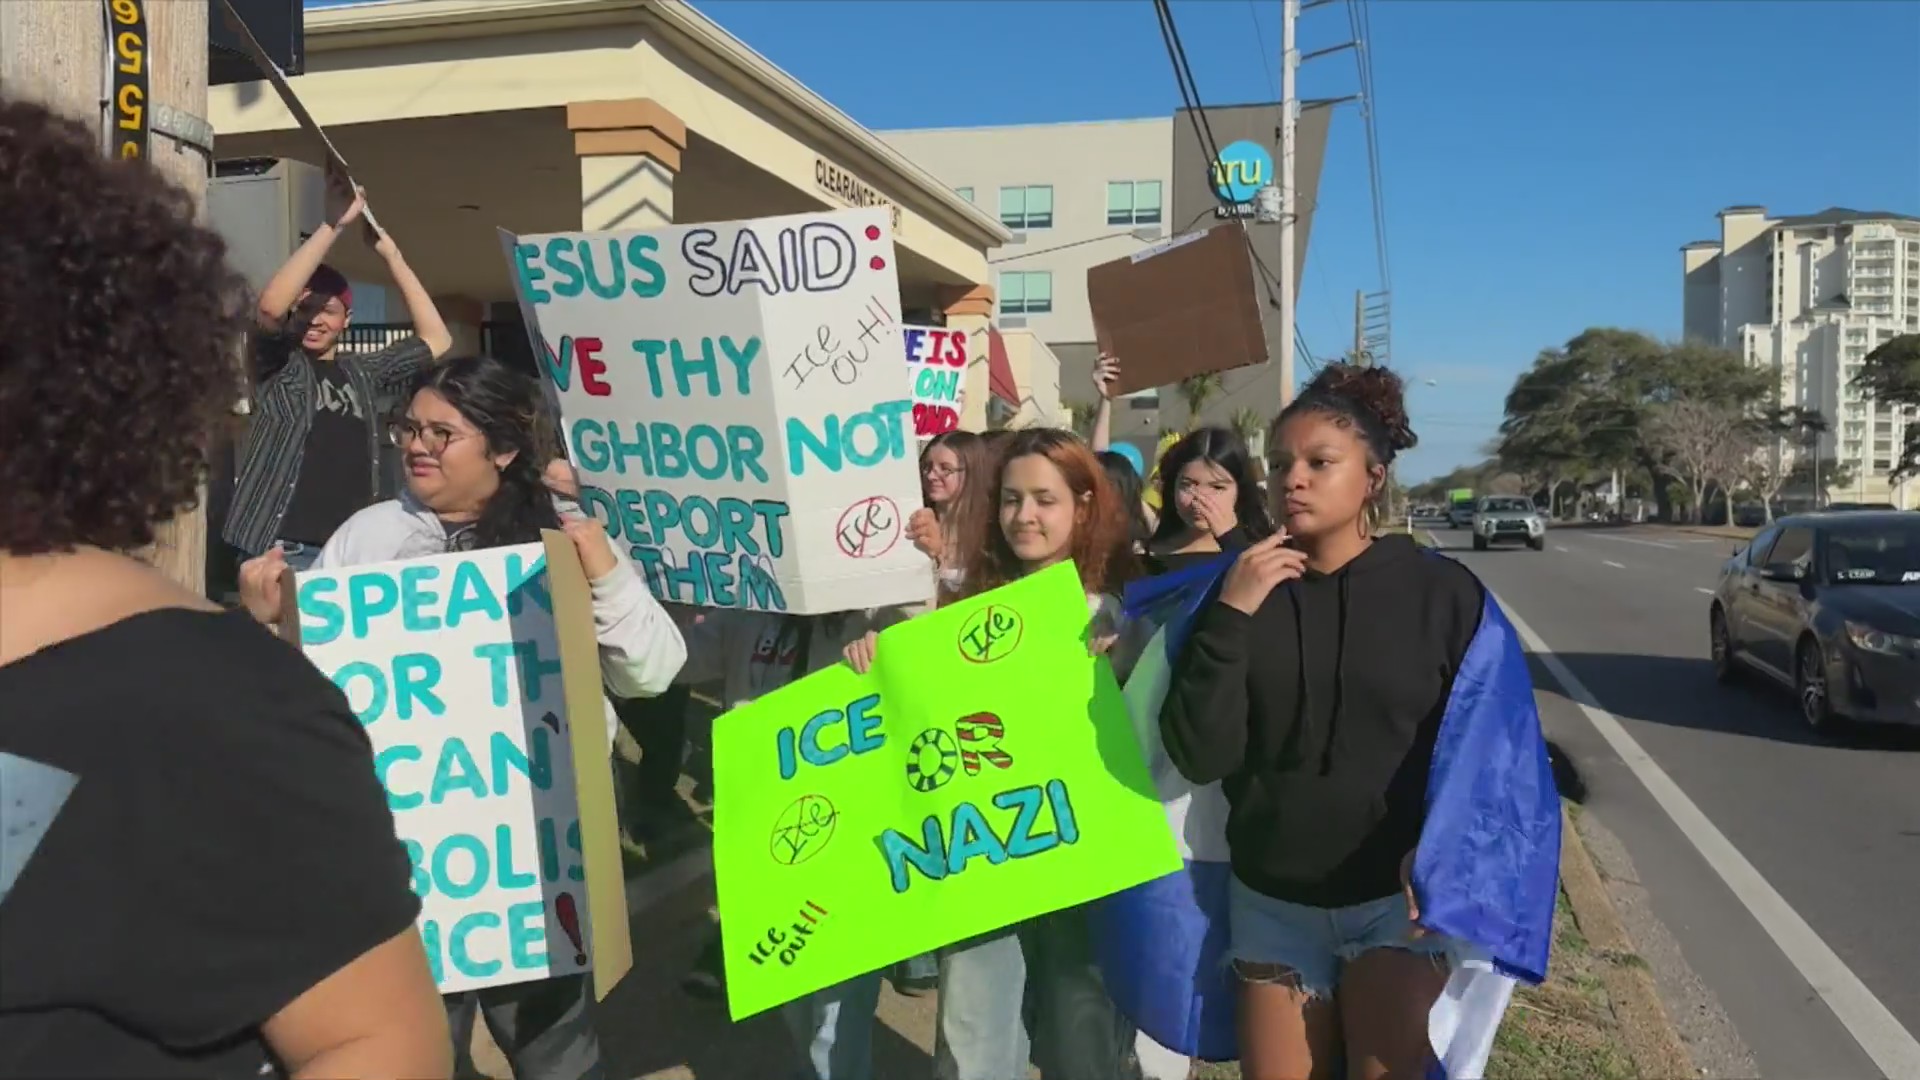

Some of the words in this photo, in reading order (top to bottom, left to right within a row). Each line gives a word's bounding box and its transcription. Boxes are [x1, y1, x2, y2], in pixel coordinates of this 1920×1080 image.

[815, 158, 877, 210] CLEARANCE
[515, 235, 667, 304] ESUS
[682, 221, 886, 298] SAID:
[545, 334, 611, 396] VE
[632, 335, 762, 398] THY
[571, 418, 769, 484] GHBOR
[786, 399, 912, 478] NOT
[579, 485, 790, 559] DEPORT
[300, 553, 553, 646] SPEAK
[630, 545, 787, 611] THEM
[331, 652, 446, 726] OR
[776, 693, 887, 781] ICE
[905, 710, 1014, 793] OR
[877, 778, 1080, 894] NAZI
